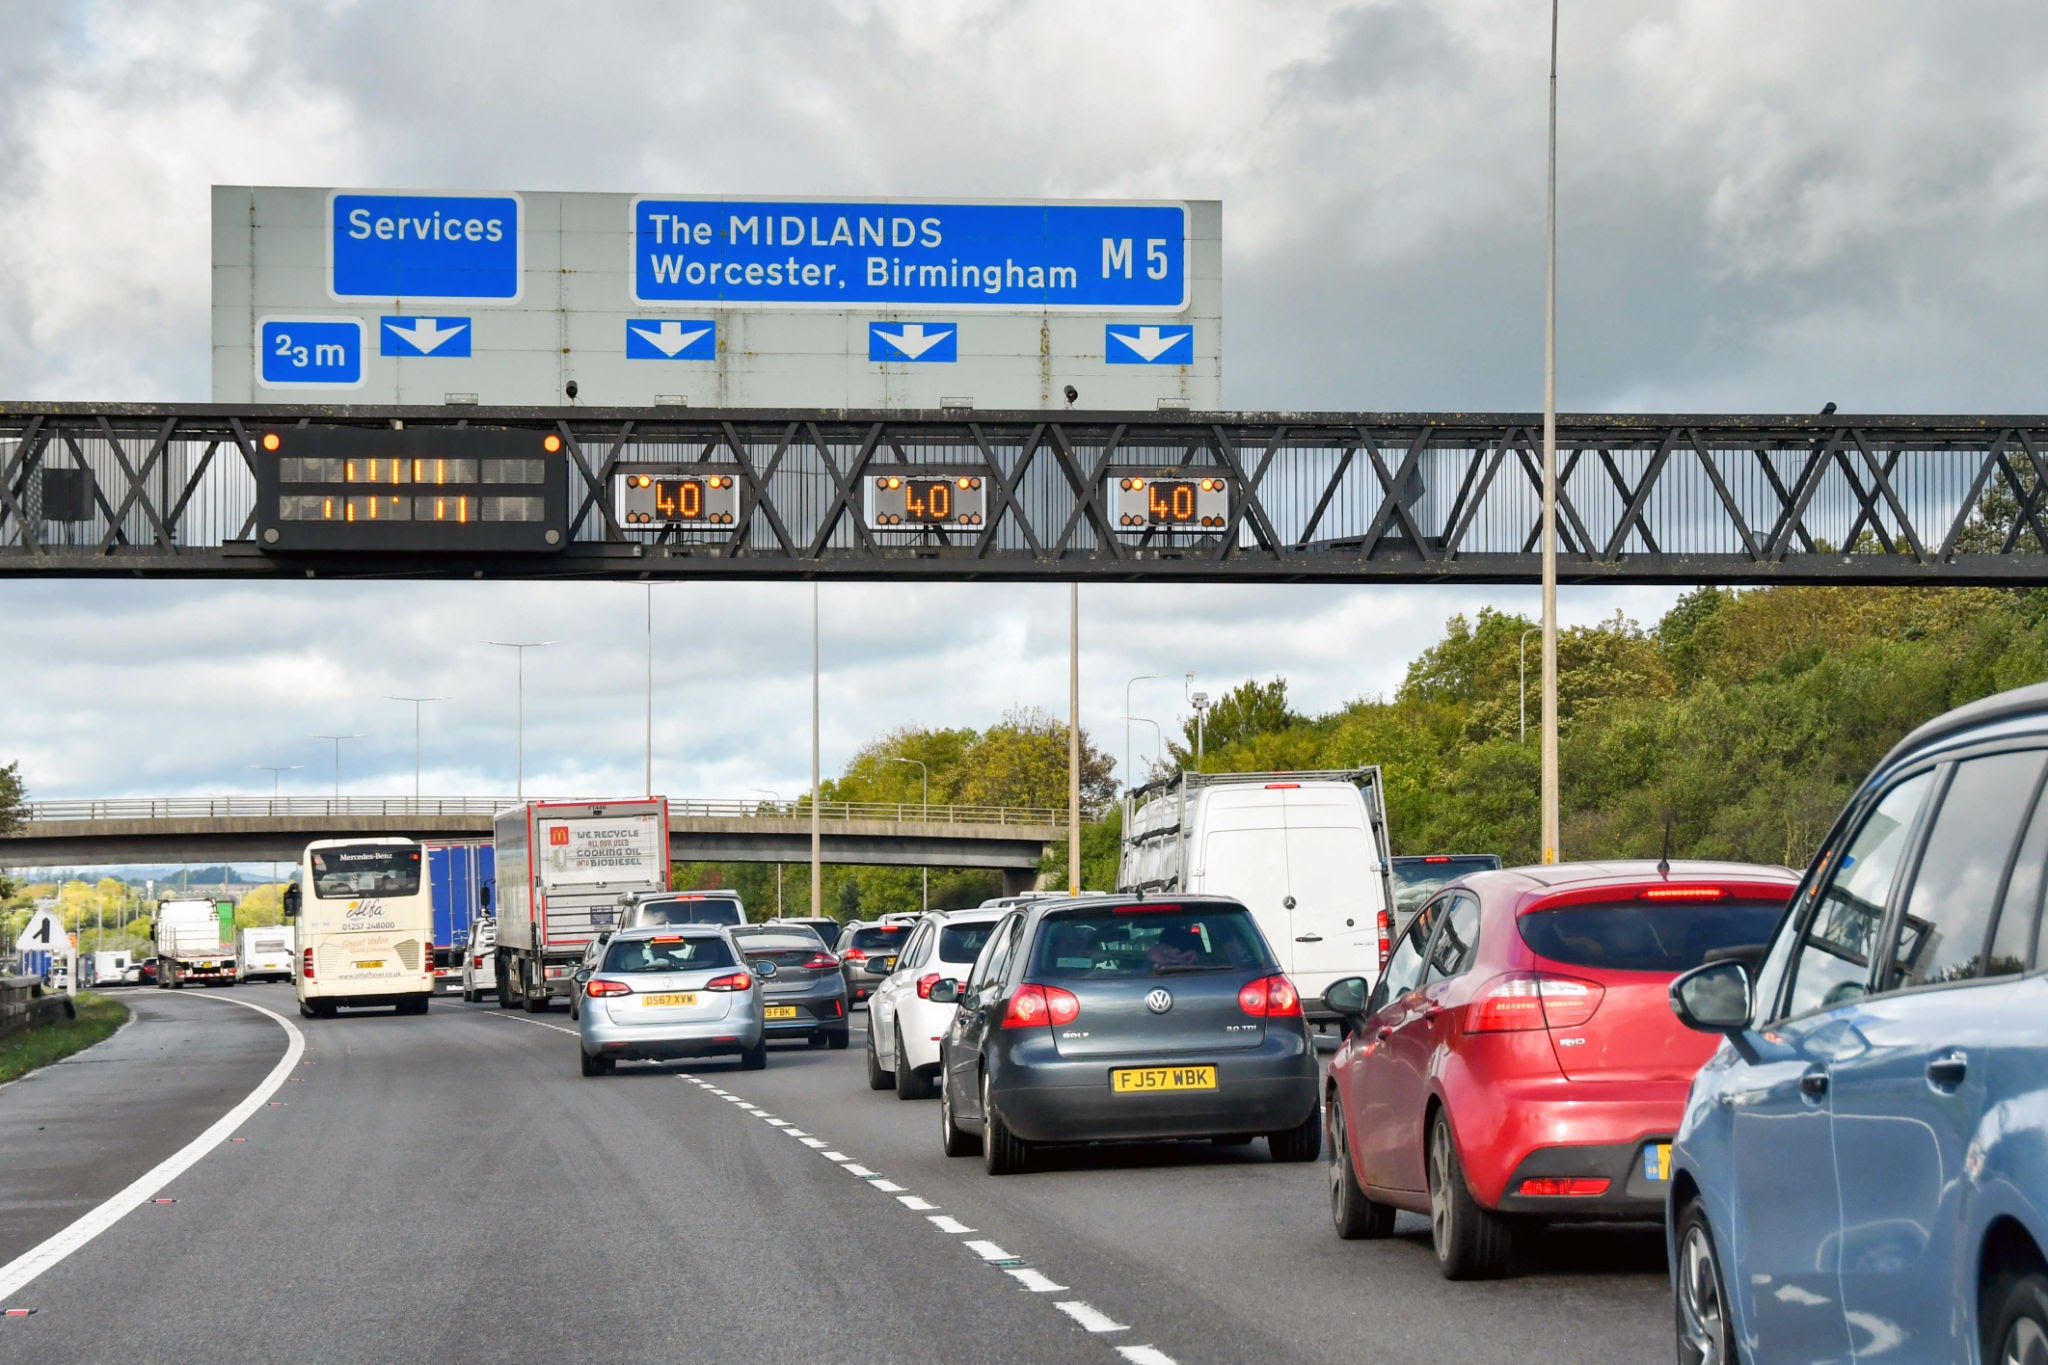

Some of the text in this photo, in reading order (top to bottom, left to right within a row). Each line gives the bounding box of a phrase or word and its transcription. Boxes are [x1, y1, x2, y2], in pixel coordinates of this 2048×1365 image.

[349, 209, 503, 242] Services
[649, 214, 942, 248] The MIDLANDS
[651, 254, 1077, 294] Worcester, Birmingham
[657, 482, 700, 517] 40
[906, 485, 949, 517] 40
[1149, 486, 1192, 519] 40
[577, 829, 639, 839] WE RECYCLE
[340, 853, 393, 861] Mercedes-Benz
[576, 847, 642, 857] COOKING OIL
[590, 857, 642, 867] BIODIESEL
[346, 898, 385, 918] Alfa
[646, 994, 671, 1006] DS67
[1121, 1068, 1208, 1088] FJ57 WBK
